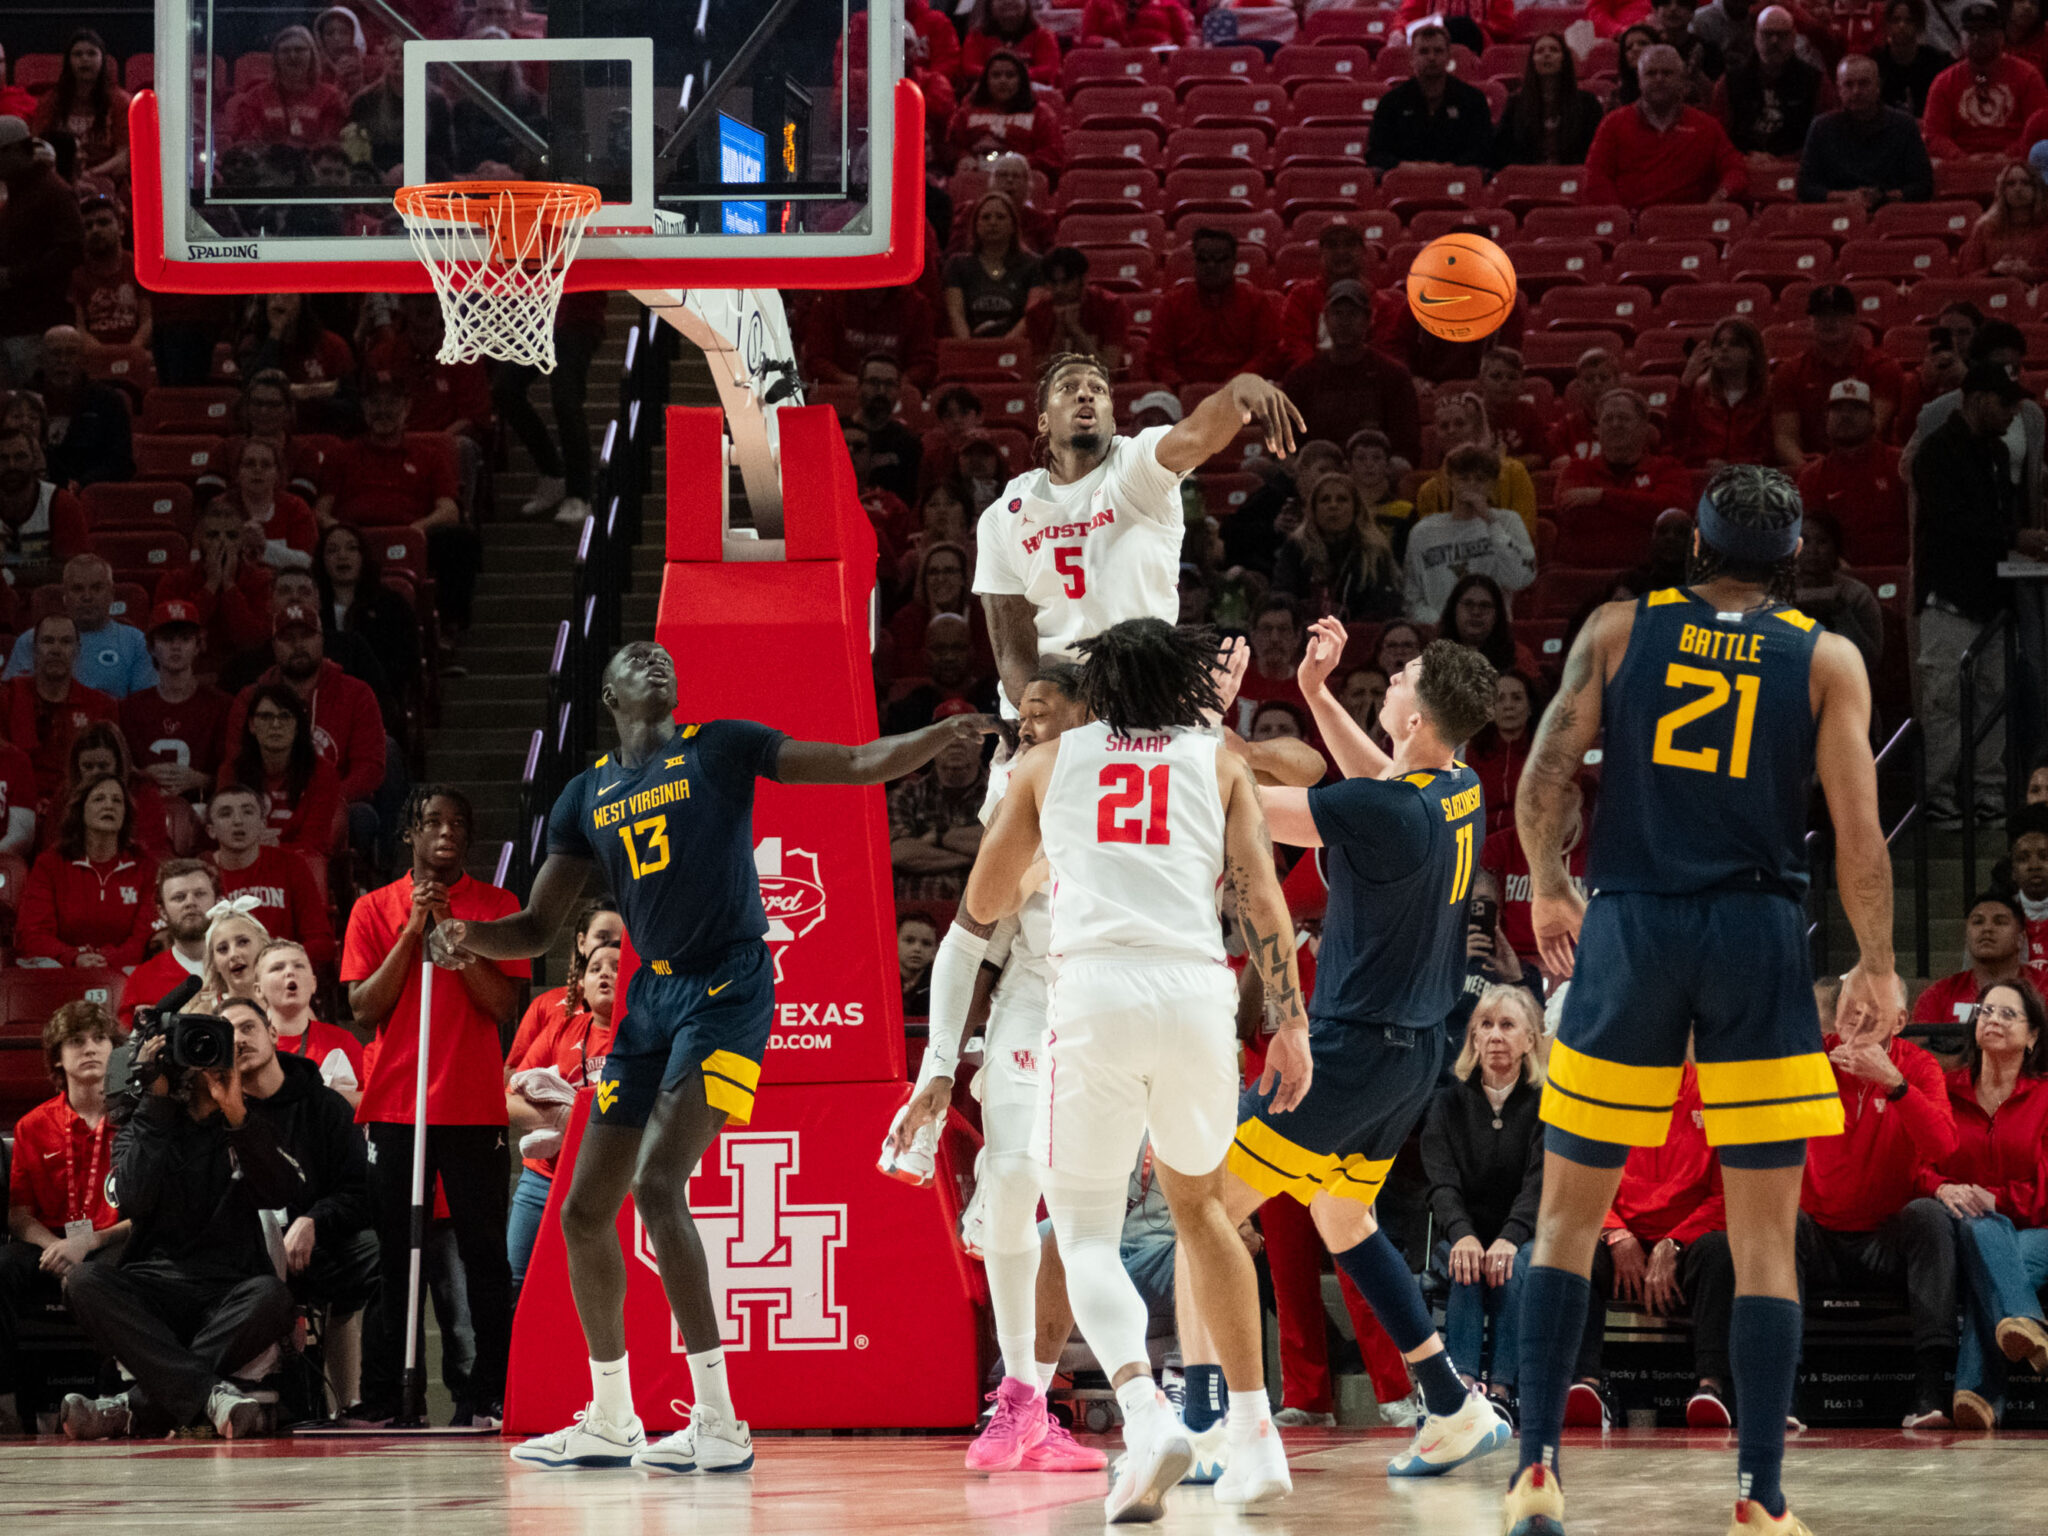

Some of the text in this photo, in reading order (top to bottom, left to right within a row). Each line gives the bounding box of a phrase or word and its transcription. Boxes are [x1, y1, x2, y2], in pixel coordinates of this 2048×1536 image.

[188, 244, 259, 260] SPALDING
[1021, 509, 1115, 555] HOUSTON
[1054, 546, 1086, 600] 5
[1679, 624, 1764, 663] BATTLE
[1105, 734, 1171, 752] SHARP
[1653, 663, 1761, 779] 21
[593, 778, 691, 830] WEST VIRGINIA
[1097, 763, 1170, 845] 21
[618, 814, 671, 881] 13
[1449, 822, 1473, 905] 11
[775, 1002, 865, 1027] EXAS
[764, 1034, 832, 1050] D.COM
